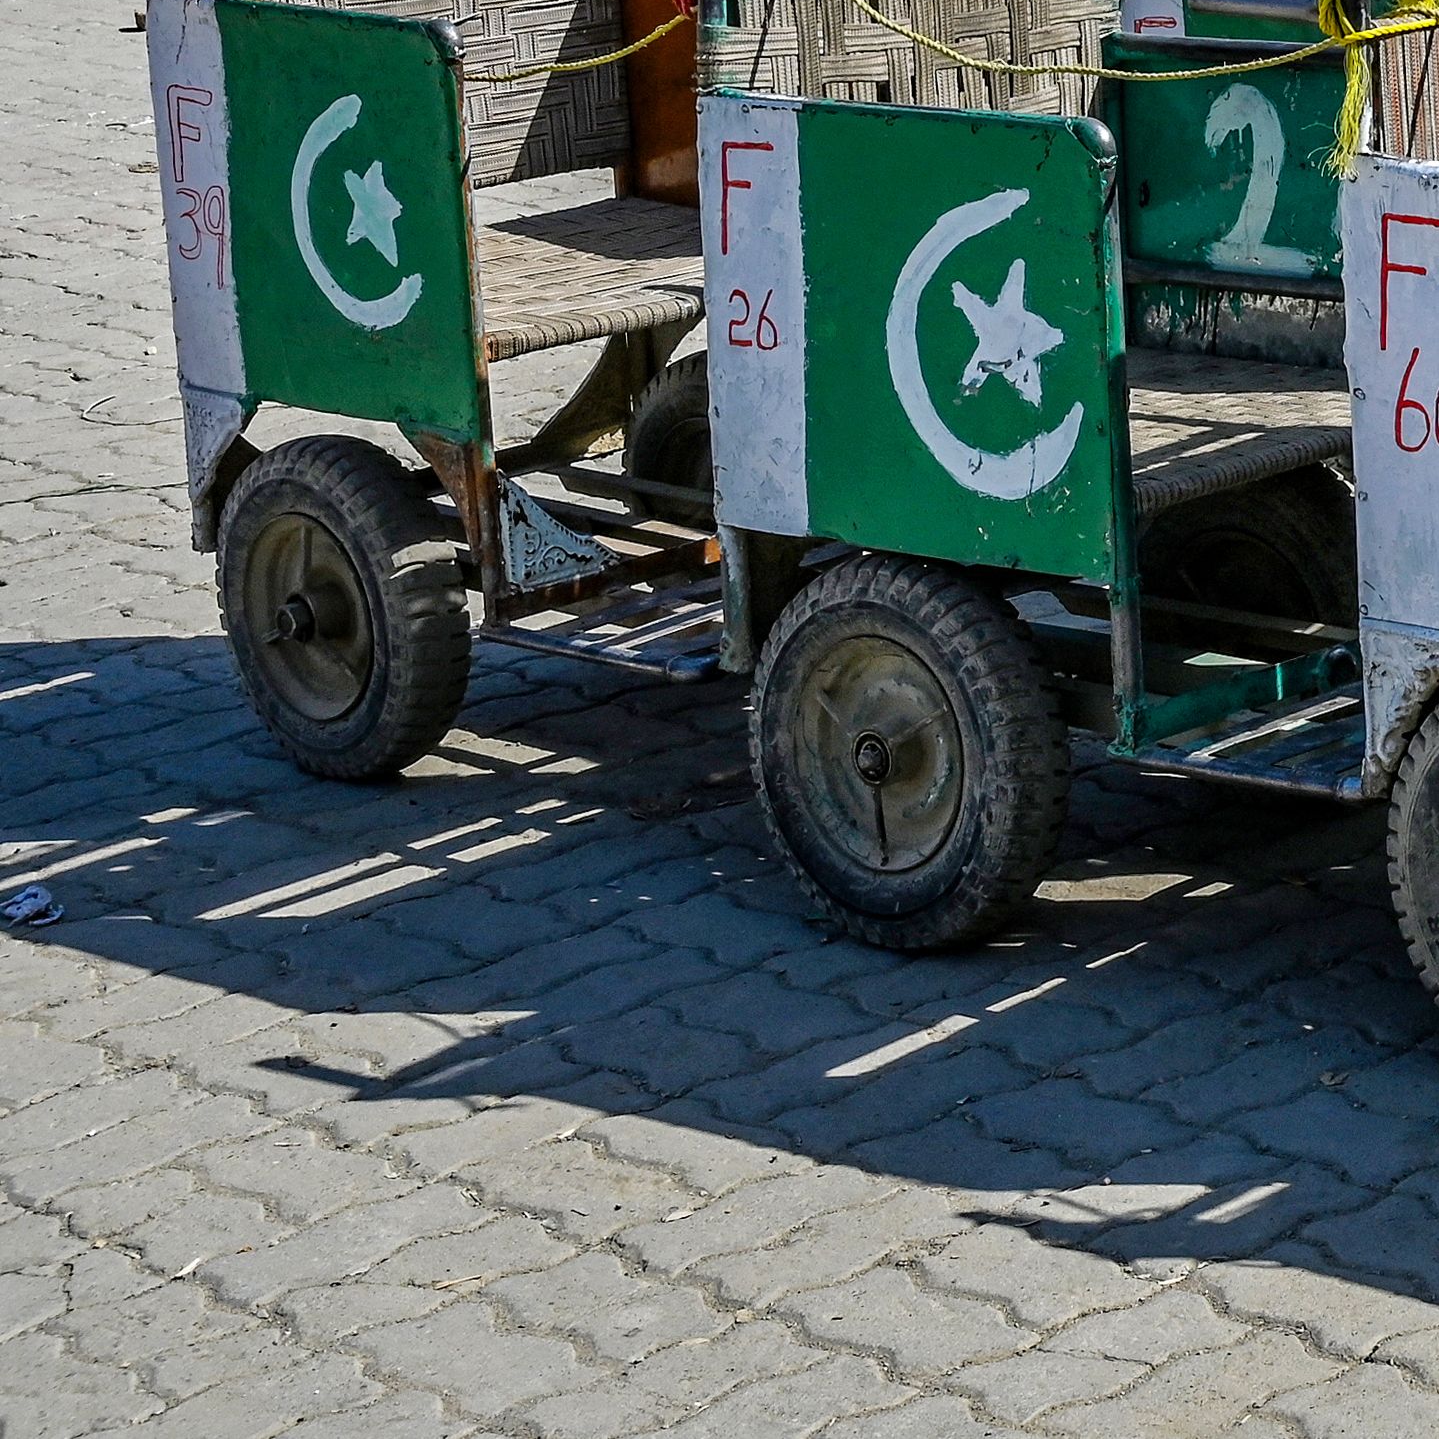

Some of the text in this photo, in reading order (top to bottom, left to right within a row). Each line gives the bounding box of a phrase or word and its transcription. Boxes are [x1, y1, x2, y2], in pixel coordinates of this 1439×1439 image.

[166, 83, 213, 183] F
[1203, 82, 1324, 274] 2
[176, 184, 227, 291] 39
[720, 141, 775, 256] F
[727, 288, 779, 352] 26
